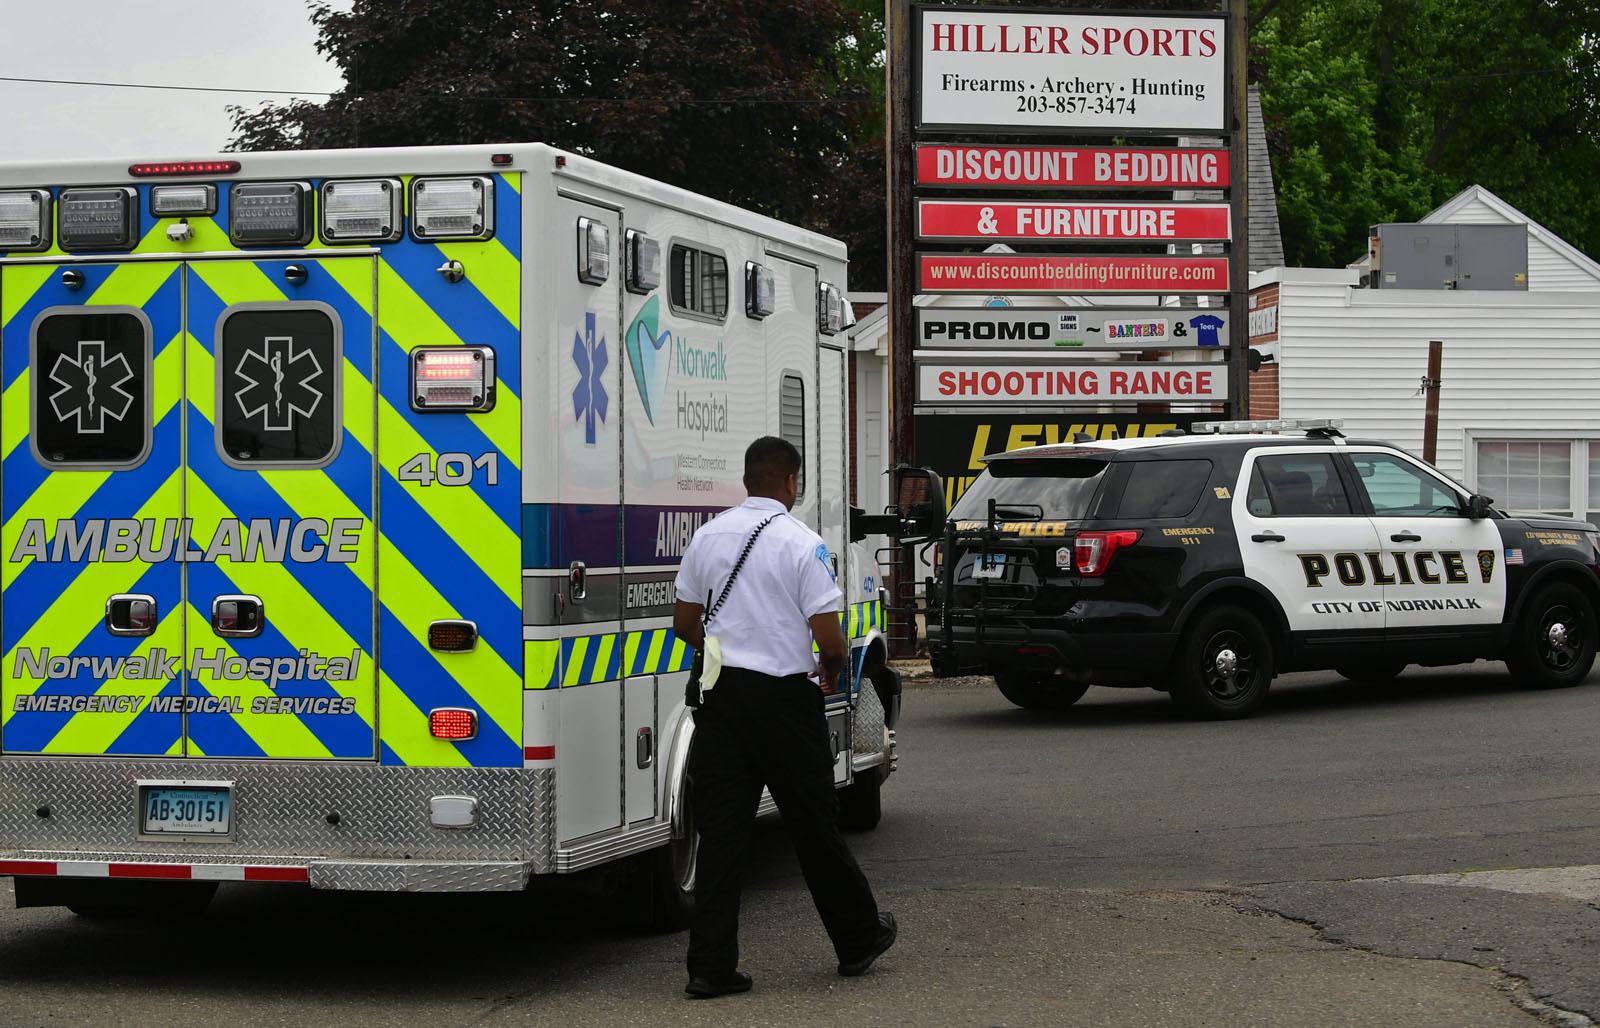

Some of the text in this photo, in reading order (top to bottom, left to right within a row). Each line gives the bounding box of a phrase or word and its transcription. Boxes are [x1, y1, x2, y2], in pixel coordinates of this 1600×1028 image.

[931, 23, 1217, 58] HILLER SPORTS
[941, 73, 1205, 101] Firearms Archery Hunting
[1016, 95, 1136, 115] 203-857-3474
[936, 149, 1218, 183] DISCOUNT BEDDING
[977, 207, 1176, 236] & FURNITURE
[930, 262, 1216, 283] www.discountbeddingfurniture.com
[923, 321, 1051, 340] PROMO
[1060, 314, 1077, 322] LAWN
[1108, 323, 1165, 338] BANNERS
[1173, 322, 1188, 337] &
[1199, 323, 1215, 331] Tees
[676, 335, 728, 381] Norwalk
[938, 370, 1213, 396] SHOOTING RANGE
[676, 390, 728, 441] Hospital
[968, 424, 1177, 470] LEV
[398, 452, 499, 487] 401
[9, 517, 364, 563] AMBULANCE
[655, 511, 720, 557] AMBU
[1161, 527, 1215, 536] EMERGENCY
[1181, 537, 1200, 545] 911
[1296, 549, 1469, 588] POLICE
[1312, 598, 1482, 614] CITY OF NORWALK
[12, 647, 361, 689] Norwalk Hospital
[13, 695, 356, 715] EMERGENCY MEDICAL SERVICES
